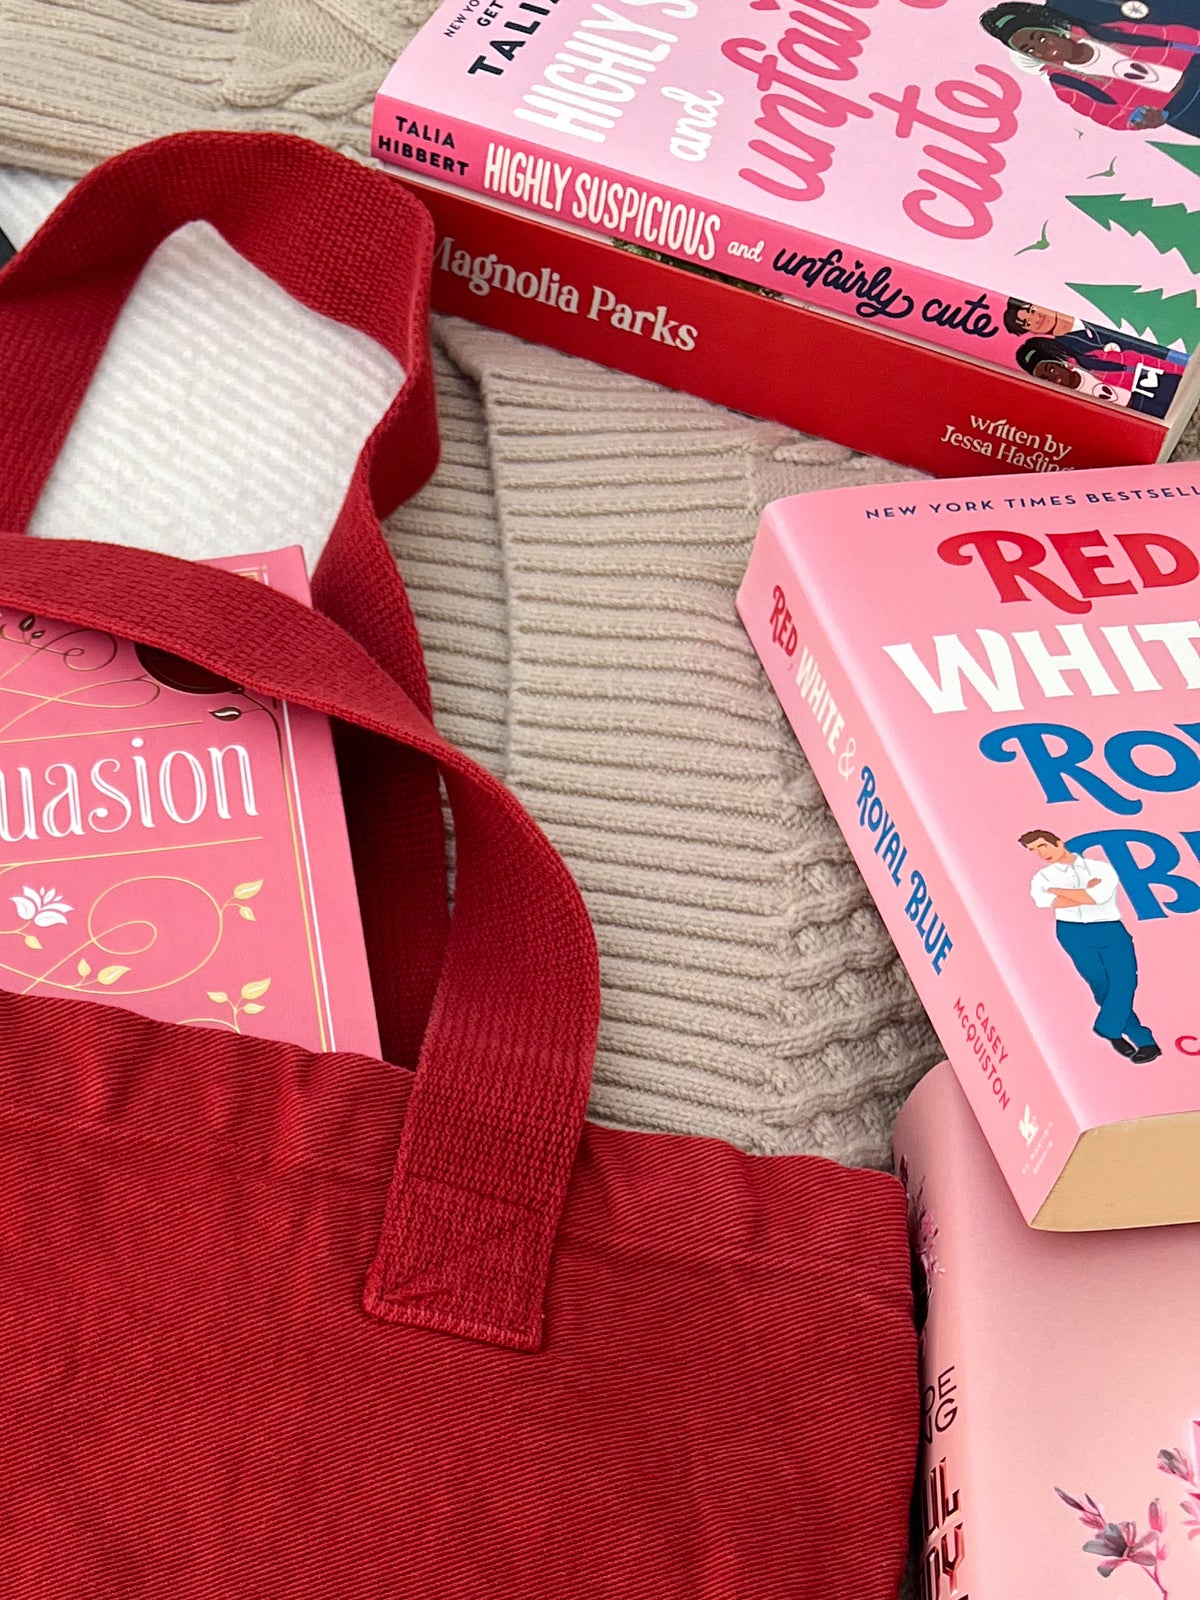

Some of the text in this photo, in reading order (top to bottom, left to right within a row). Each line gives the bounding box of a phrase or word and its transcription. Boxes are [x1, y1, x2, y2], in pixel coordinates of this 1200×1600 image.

[467, 0, 559, 76] TALI
[513, 3, 679, 143] HIGHLY
[395, 115, 455, 149] TALIA
[660, 86, 726, 163] and
[721, 0, 879, 202] unfai
[378, 135, 469, 176] HIBBERT
[868, 64, 1023, 240] cute
[483, 142, 1000, 338] HIGHLY SUSPICIOUS and unfairly cute
[586, 285, 699, 351] Parks
[940, 425, 993, 457] Jessa
[970, 414, 1073, 461] written by
[866, 505, 917, 520] NEW
[929, 499, 995, 514] YORK
[1004, 494, 1077, 510] TIMES
[937, 529, 1200, 615] RED
[881, 620, 1200, 714] WHIT
[796, 646, 845, 755] WHITE
[837, 737, 857, 782] &
[856, 765, 908, 888] ROYAL
[904, 870, 953, 977] BLUE
[953, 997, 1011, 1111] McQUISTON
[975, 1002, 1008, 1064] CASEY
